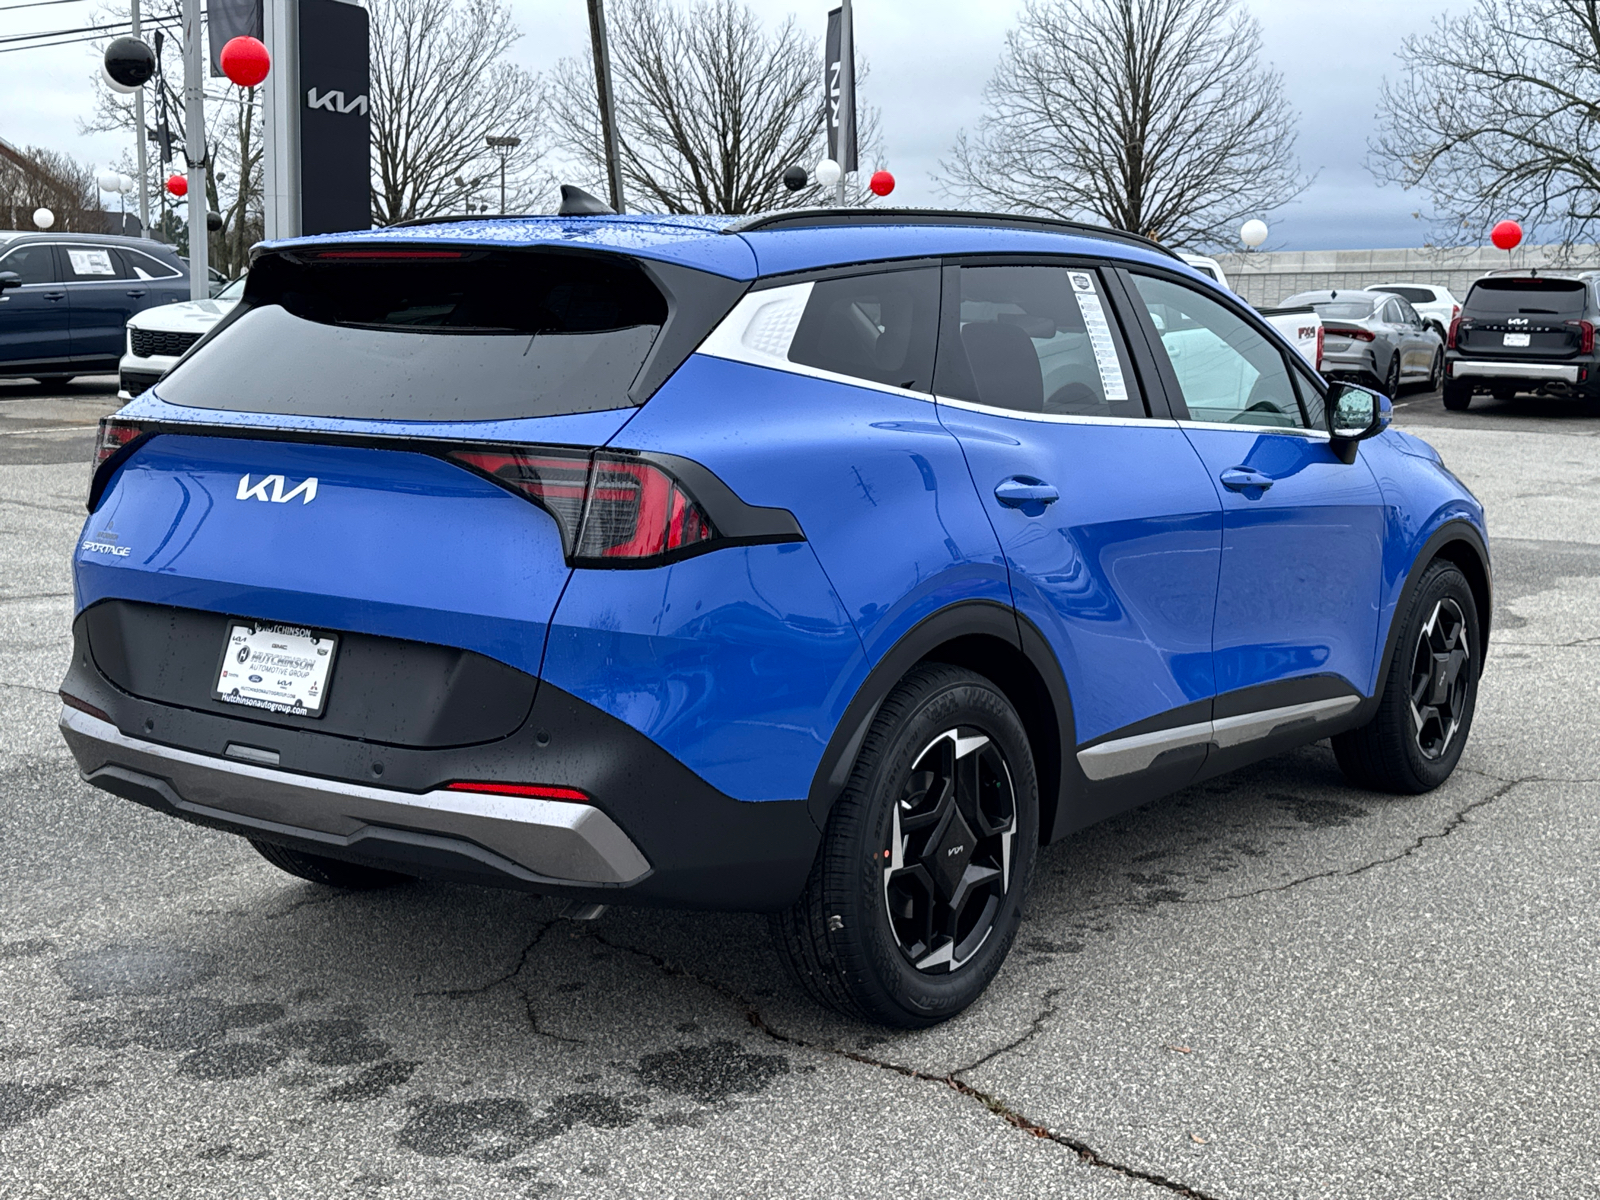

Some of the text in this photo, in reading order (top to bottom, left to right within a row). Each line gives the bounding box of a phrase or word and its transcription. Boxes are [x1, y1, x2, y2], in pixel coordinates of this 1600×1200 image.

[307, 87, 368, 116] KIA
[236, 473, 318, 504] KIA
[82, 541, 131, 557] SPORTAGE
[249, 663, 310, 678] AUTOMOTIVE GROUP
[250, 651, 316, 671] HUTCHINSON
[221, 692, 308, 716] Hutchinsonautogroup.com
